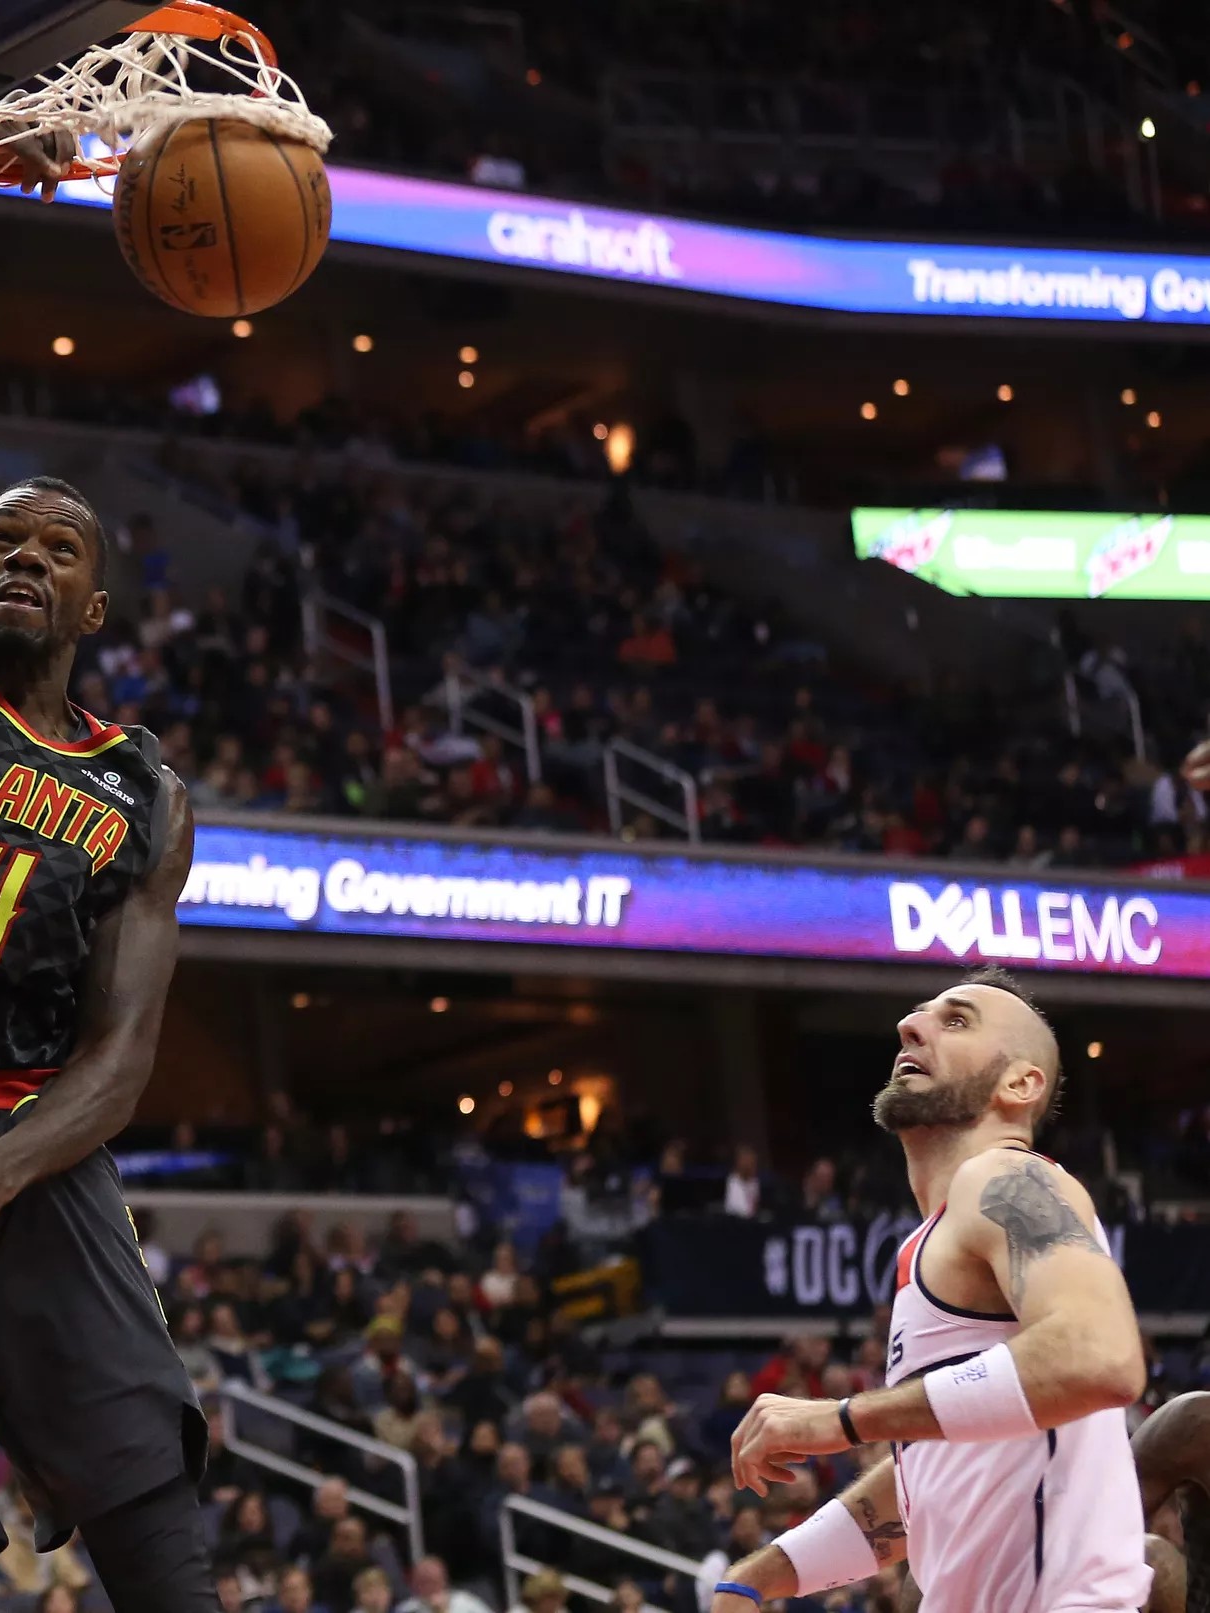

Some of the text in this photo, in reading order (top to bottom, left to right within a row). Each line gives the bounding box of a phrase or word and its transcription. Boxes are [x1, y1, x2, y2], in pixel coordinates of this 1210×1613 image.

[487, 208, 684, 278] carahsoft
[907, 258, 1146, 319] Transforming
[81, 769, 135, 806] sharecare
[178, 853, 632, 927] rming Government IT
